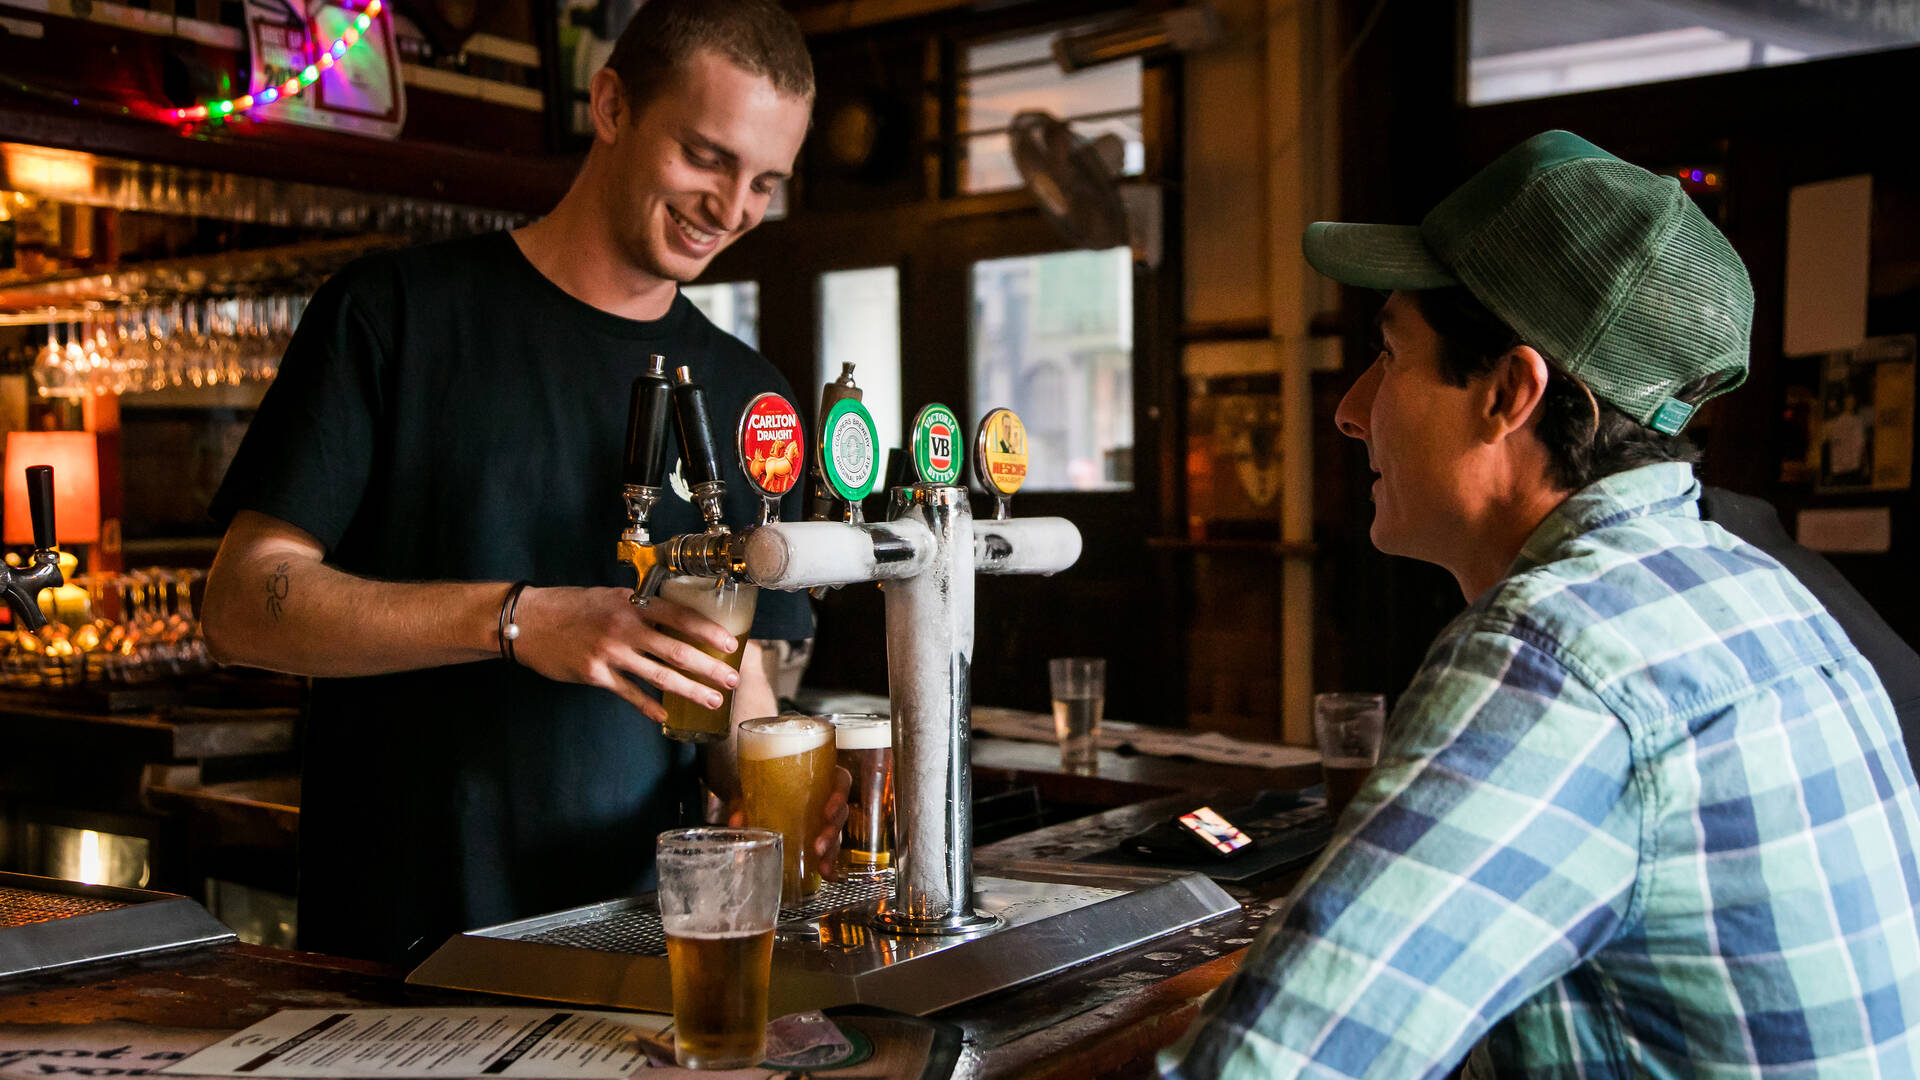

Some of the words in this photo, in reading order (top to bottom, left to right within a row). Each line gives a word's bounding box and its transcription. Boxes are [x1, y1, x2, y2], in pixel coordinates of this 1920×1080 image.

[751, 414, 796, 429] CARLTON
[924, 413, 955, 433] VICTORIA
[757, 430, 793, 441] DRAUGHT
[836, 418, 851, 447] COOPERS
[852, 418, 870, 447] BREWERY
[931, 437, 950, 457] VB
[836, 455, 855, 483] ORIGINAL
[927, 466, 954, 481] BITTER
